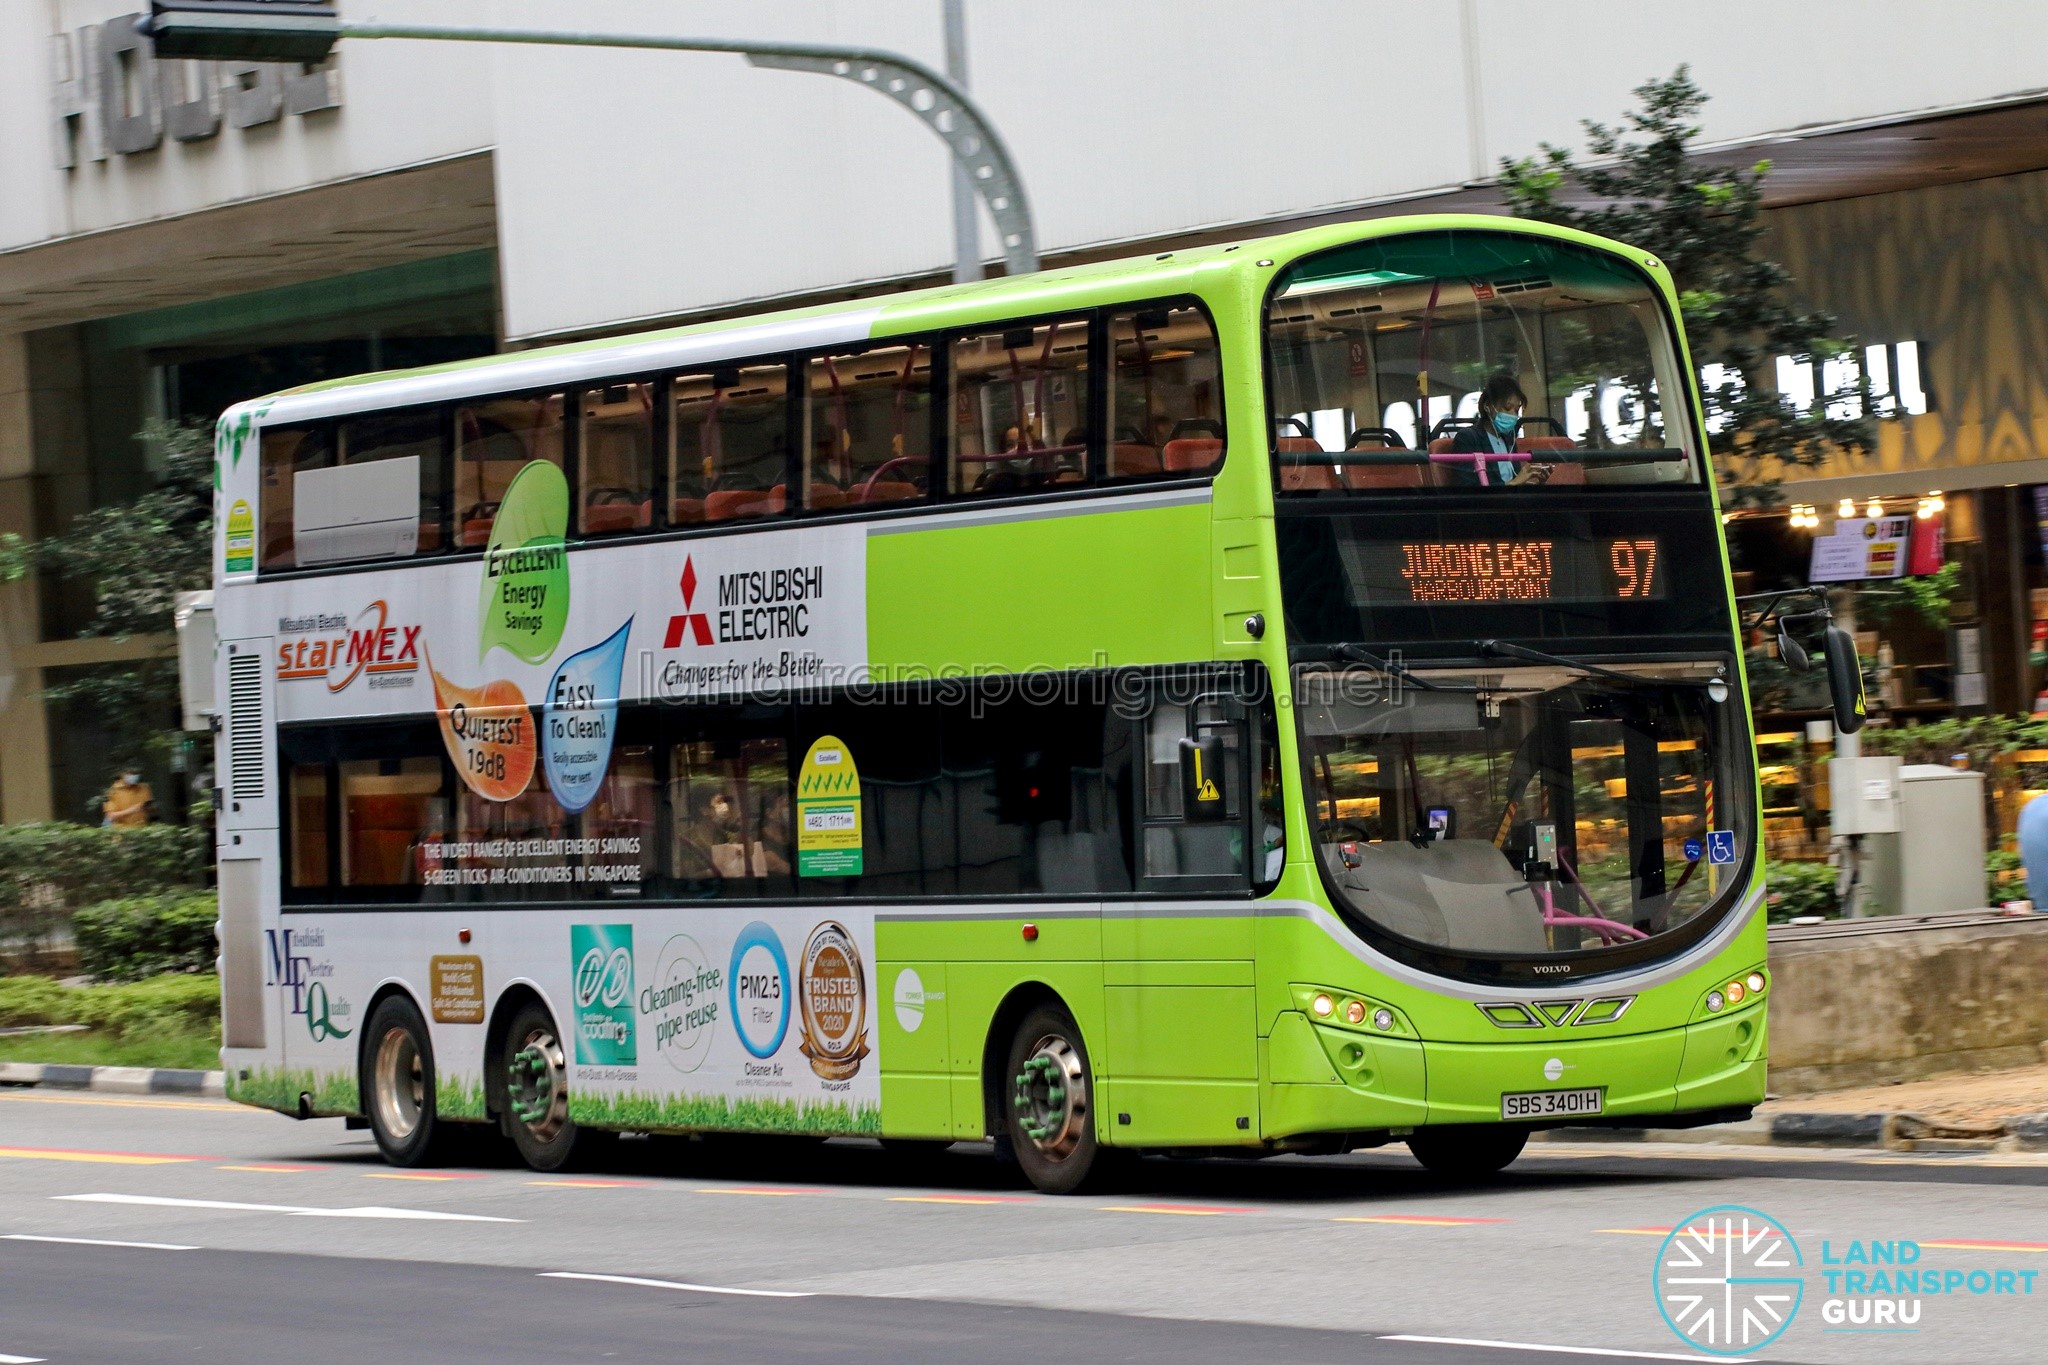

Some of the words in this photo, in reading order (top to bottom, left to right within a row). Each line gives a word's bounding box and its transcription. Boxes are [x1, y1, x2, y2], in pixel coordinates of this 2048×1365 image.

[1401, 543, 1493, 578] JURONG
[1496, 542, 1552, 577] EAST
[1611, 540, 1656, 597] 97
[503, 582, 547, 609] Energy
[719, 565, 823, 607] MITSUBISHI
[1411, 577, 1551, 601] HARBOURFRONT
[505, 611, 543, 635] Savings
[719, 603, 809, 643] ELECTRIC
[664, 659, 722, 688] Changes
[726, 659, 748, 685] for
[752, 656, 773, 678] the
[778, 651, 824, 678] Better
[554, 675, 595, 711] EASY
[451, 702, 522, 745] QUIETEST
[550, 717, 564, 739] To
[567, 713, 607, 739] Clean!
[467, 748, 506, 781] 19dB
[423, 843, 441, 859] THE
[441, 842, 473, 858] WIDEST
[473, 841, 503, 857] RANGE
[503, 841, 516, 857] OF
[517, 839, 564, 857] EXCELLENT
[565, 838, 600, 855] ENERGY
[601, 837, 640, 854] SAVINGS
[462, 868, 488, 885] TICKS
[490, 865, 573, 884] AIR-CONDITIONERS
[574, 865, 586, 882] IN
[588, 864, 641, 882] SINGAPORE
[1533, 964, 1570, 974] VOLVO
[740, 975, 780, 1000] PM2.5
[805, 976, 859, 995] TRUSTED
[752, 1006, 773, 1025] Filter
[814, 995, 853, 1013] BRAND
[656, 1012, 683, 1051] pipe
[685, 1001, 718, 1031] reuse
[822, 1014, 844, 1031] 2020
[827, 1041, 842, 1050] GOLD
[744, 1062, 771, 1076] Cleaner
[773, 1062, 784, 1077] Air
